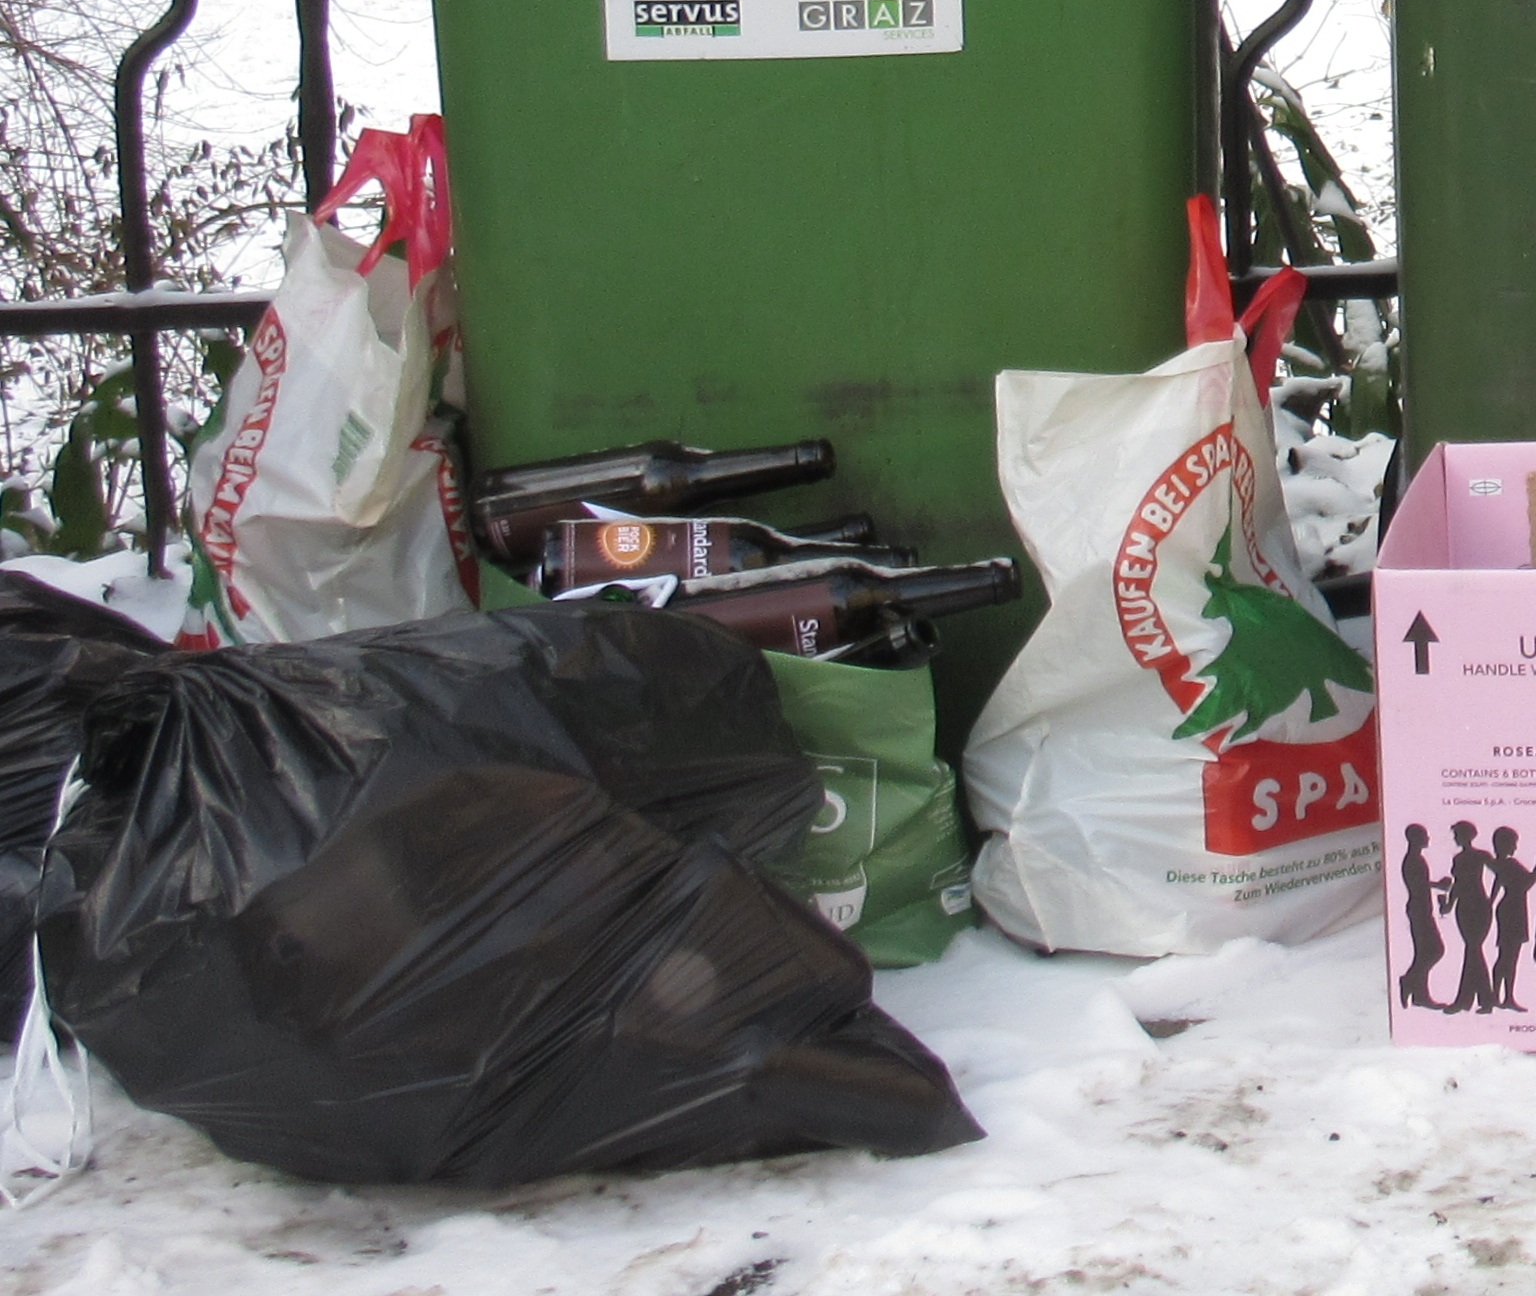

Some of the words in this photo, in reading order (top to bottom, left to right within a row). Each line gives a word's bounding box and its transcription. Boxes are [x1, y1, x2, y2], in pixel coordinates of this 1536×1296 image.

[636, 1, 739, 24] servus
[665, 26, 712, 36] ABFALL
[799, 0, 933, 29] GRAZ
[883, 28, 935, 40] SERVICES
[216, 428, 264, 504] BEIM
[1140, 470, 1191, 533] BEI
[692, 517, 712, 578] andard
[1119, 532, 1172, 661] KAUFEN
[799, 618, 819, 657] Stan
[1463, 664, 1526, 676] HANDLE
[1441, 769, 1499, 779] CONTAINS
[1502, 769, 1509, 778] 6
[1252, 762, 1370, 832] SPA
[1166, 870, 1206, 884] Diese
[1212, 870, 1256, 884] Tasche
[1259, 859, 1304, 880] besteht
[1306, 858, 1321, 869] zu
[1351, 845, 1370, 858] aus
[1234, 887, 1262, 902] Zum
[1265, 862, 1371, 896] Wiederverwenden
